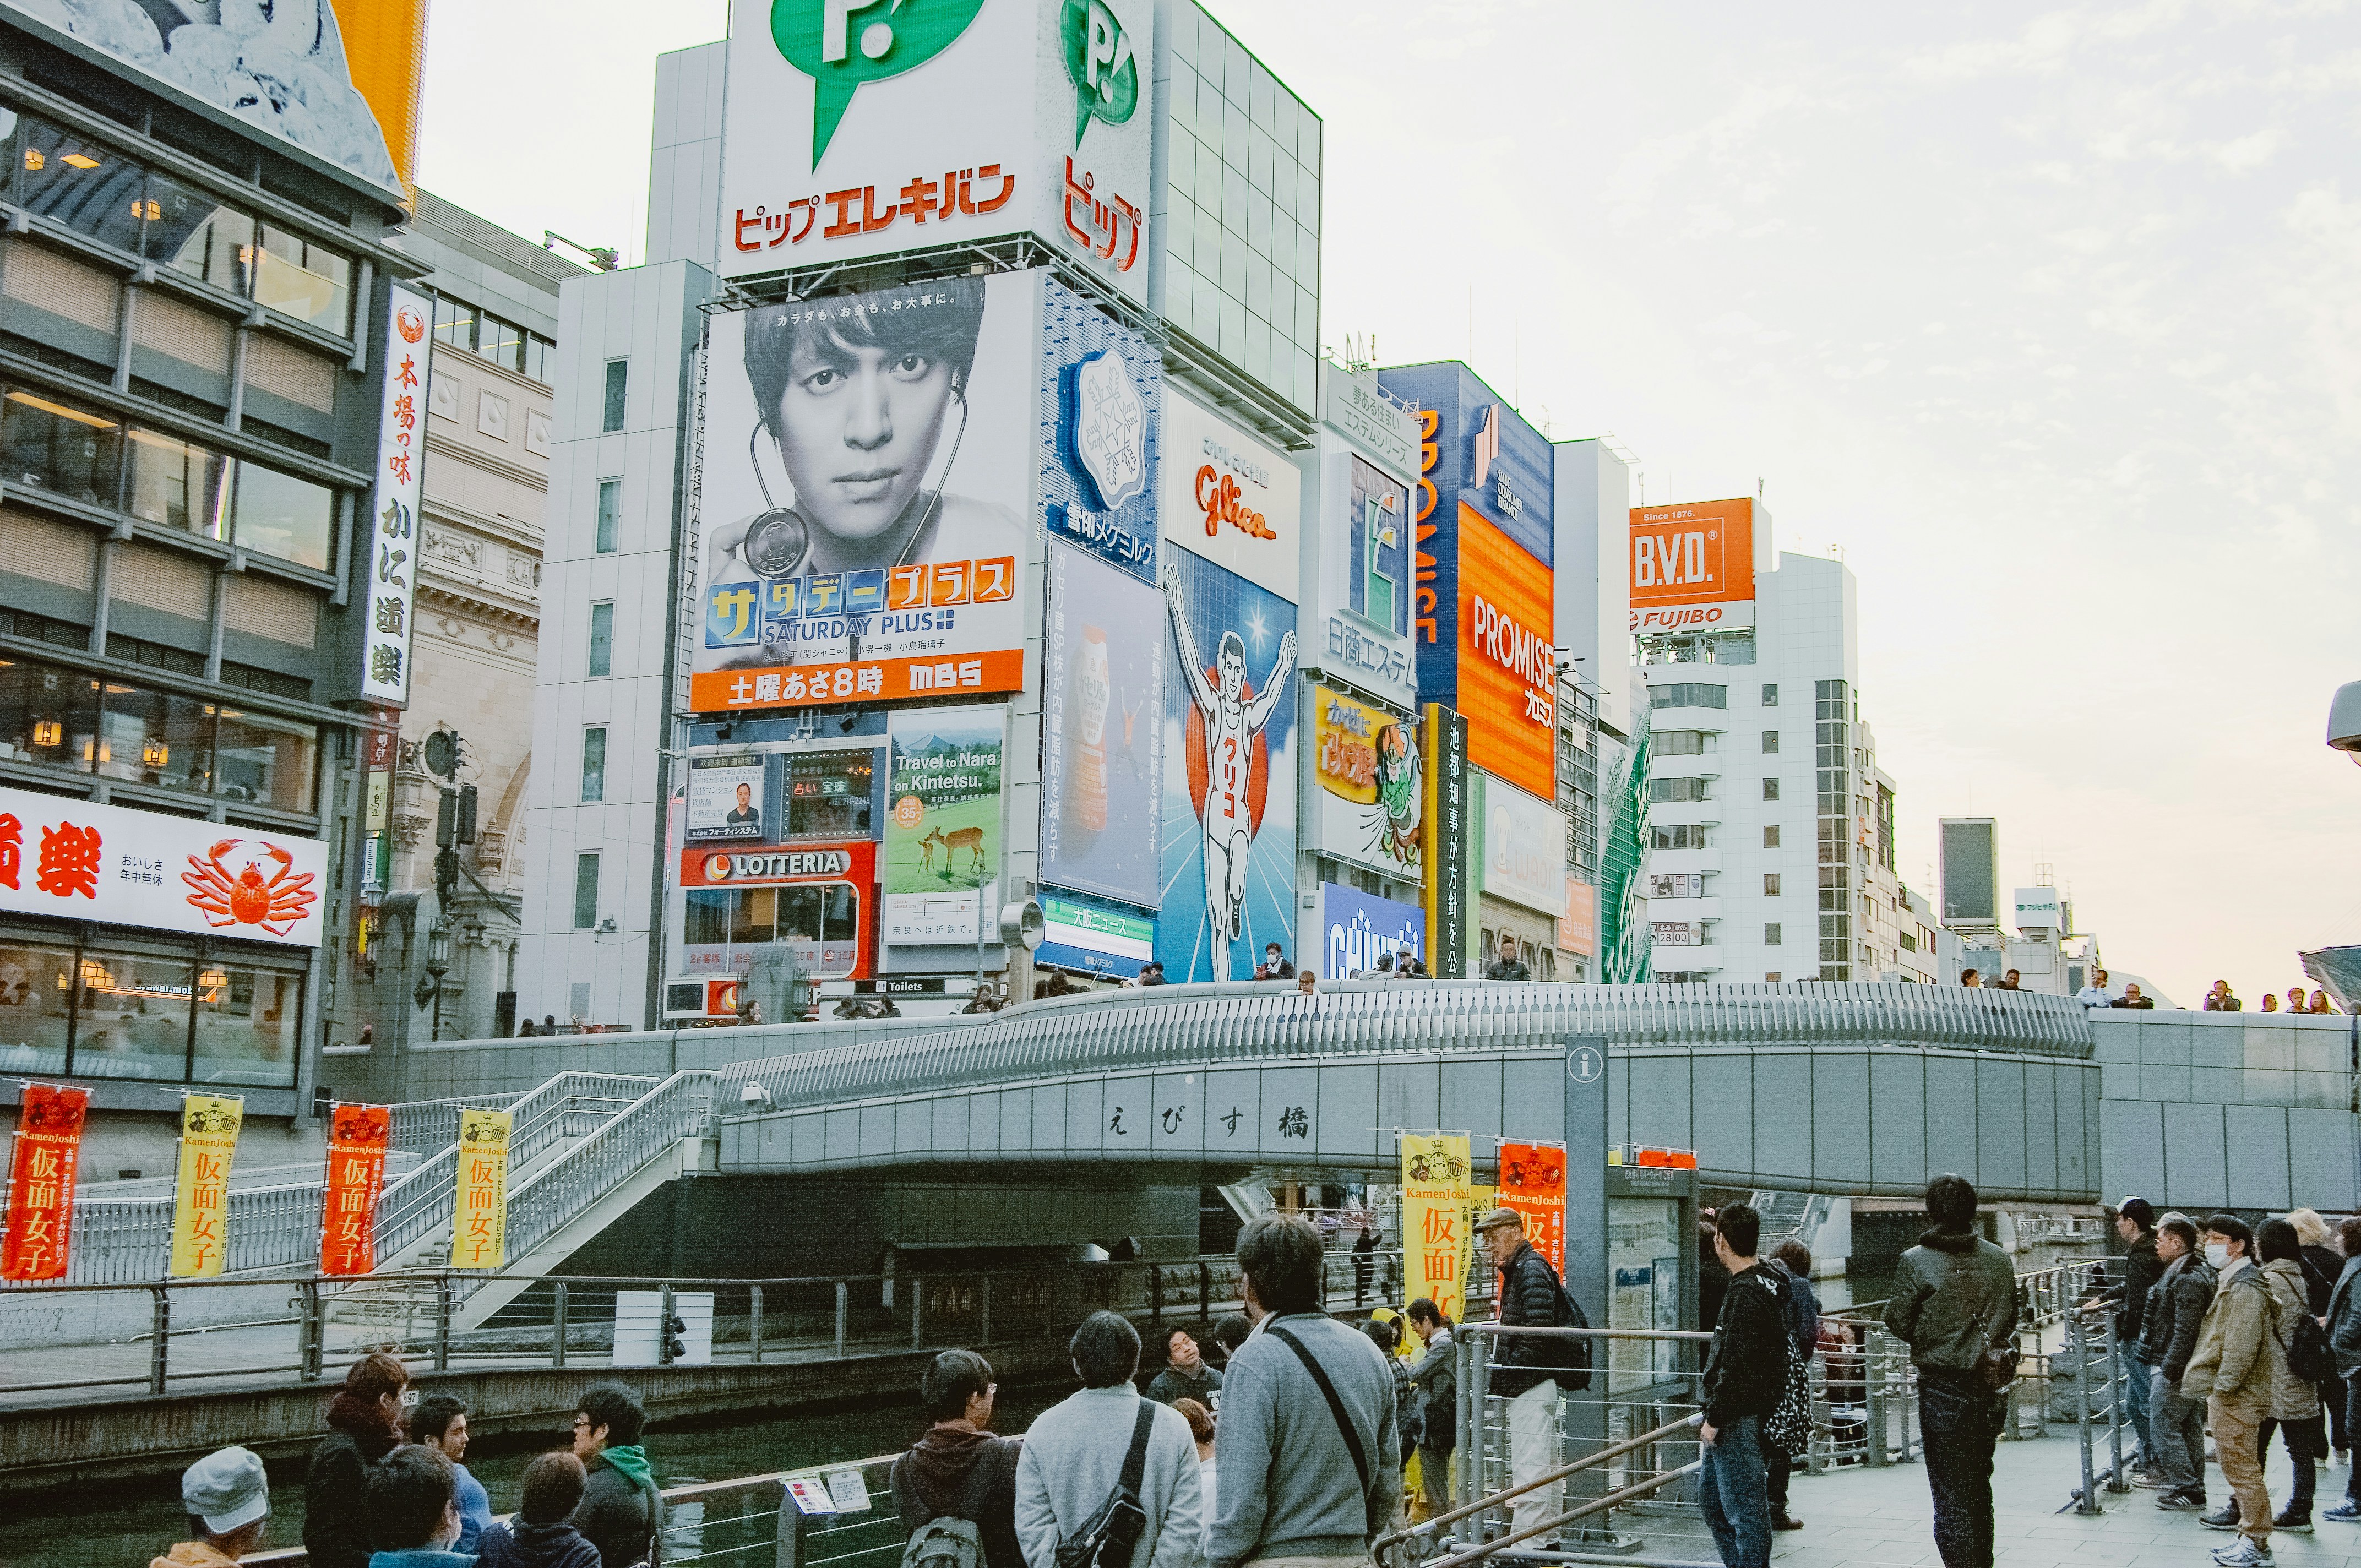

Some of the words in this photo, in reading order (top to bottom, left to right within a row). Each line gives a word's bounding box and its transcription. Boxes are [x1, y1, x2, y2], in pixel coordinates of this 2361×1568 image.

[1063, 155, 1143, 273] ピップ
[777, 293, 956, 327] カラダも、お金も、お大事に。
[388, 353, 419, 486] 本場の味
[1353, 384, 1400, 431] 夢ある住まい
[1344, 409, 1407, 466] エステムシリーズ
[1195, 465, 1276, 540] Glico
[1643, 513, 1669, 521] Since
[1672, 510, 1695, 519] 1876.
[1066, 502, 1153, 565] 雪印メグミルク
[1634, 531, 1713, 587] B.V.D.
[712, 560, 1012, 641] サタデープラス
[763, 617, 873, 646] SATURDAY
[882, 611, 933, 635] PLUS
[1643, 608, 1723, 630] FUJIBO
[1329, 617, 1419, 693] 日商エステム
[1474, 595, 1554, 698] PROMISE
[728, 665, 883, 705] 土曜あさ8時
[1525, 687, 1554, 730] プロミス
[896, 754, 944, 771] Travel
[946, 758, 958, 768] to
[959, 752, 997, 767] Nara
[1223, 733, 1239, 819] グリコ
[794, 782, 817, 796] 占い
[895, 782, 909, 791] on
[911, 775, 983, 791] Kintetsu.
[901, 807, 916, 819] 35
[709, 826, 758, 836] フォーティシステム
[120, 869, 163, 886] 年中無休
[122, 854, 163, 872] おいしさ
[735, 852, 841, 876] LOTTERIA
[892, 925, 972, 935] 奈良へは近鉄で。
[1073, 906, 1127, 935] 大阪ニュース
[888, 982, 923, 993] Toilets
[21, 1129, 80, 1145] KamenJoshi
[1109, 1104, 1309, 1140] えびす橋
[184, 1136, 237, 1148] KamenJoshi
[333, 1144, 387, 1156] KamenJoshi
[461, 1145, 508, 1156] KamenJoshi
[19, 1146, 61, 1274] 仮面女子
[187, 1152, 223, 1270] 仮面女子
[465, 1158, 494, 1264] 仮面女子
[1406, 1188, 1470, 1200] KamenJoshi
[1502, 1190, 1565, 1206] KamenJoshi
[336, 1158, 370, 1269] 仮面女子
[1519, 1210, 1547, 1252] 仮
